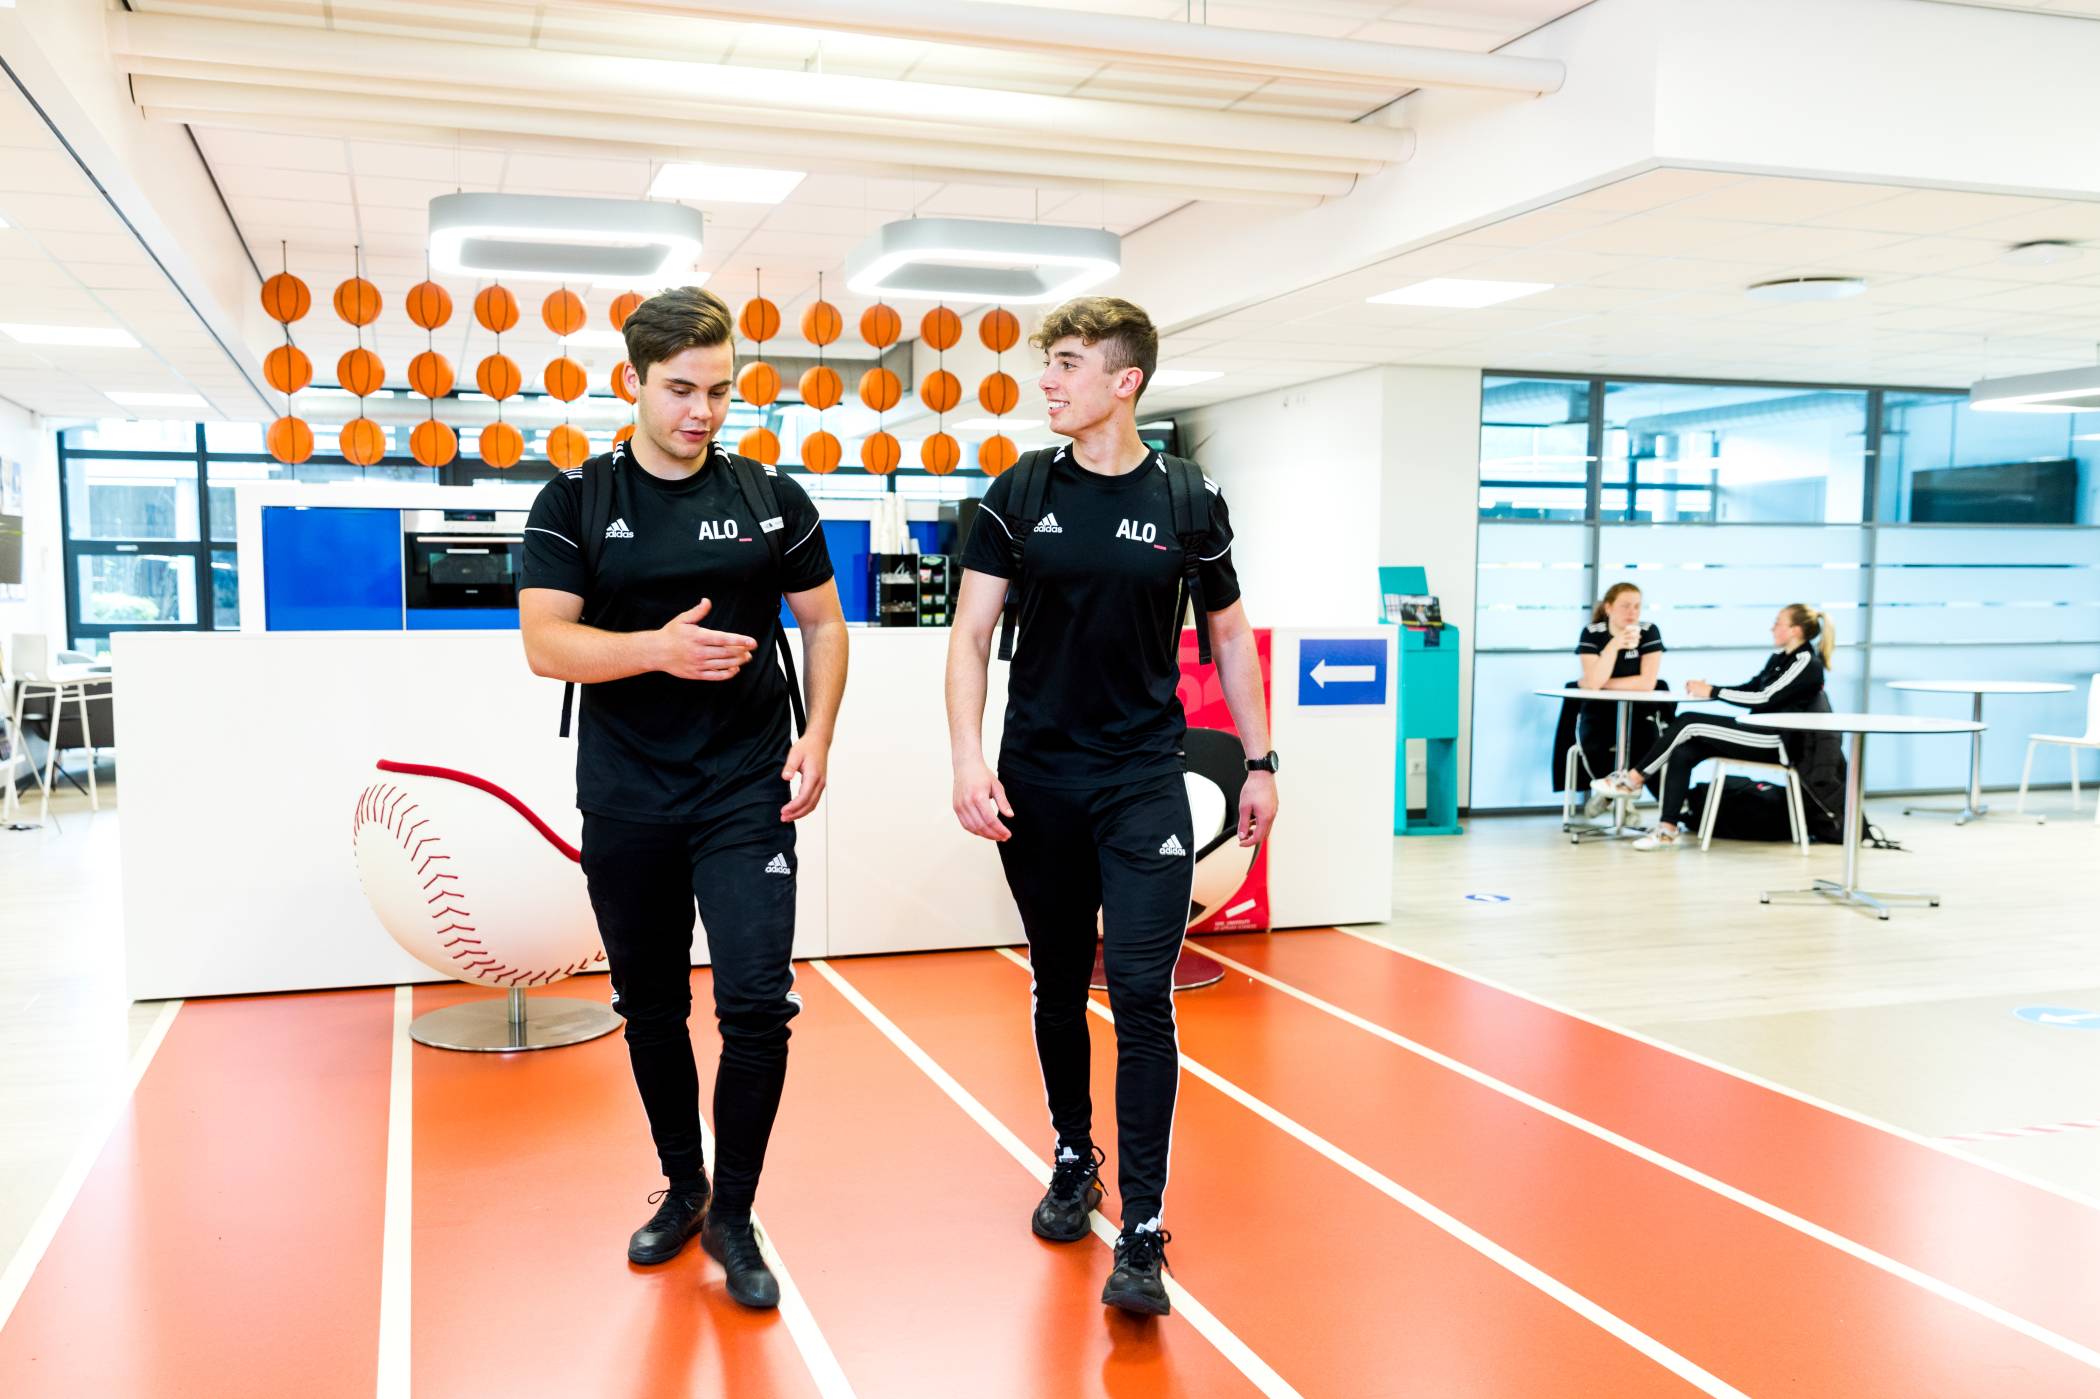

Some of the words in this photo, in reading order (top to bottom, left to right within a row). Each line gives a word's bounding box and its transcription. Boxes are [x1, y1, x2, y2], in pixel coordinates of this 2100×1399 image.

[699, 519, 738, 540] ALO
[1033, 525, 1063, 534] adidas
[1115, 518, 1157, 543] ALO
